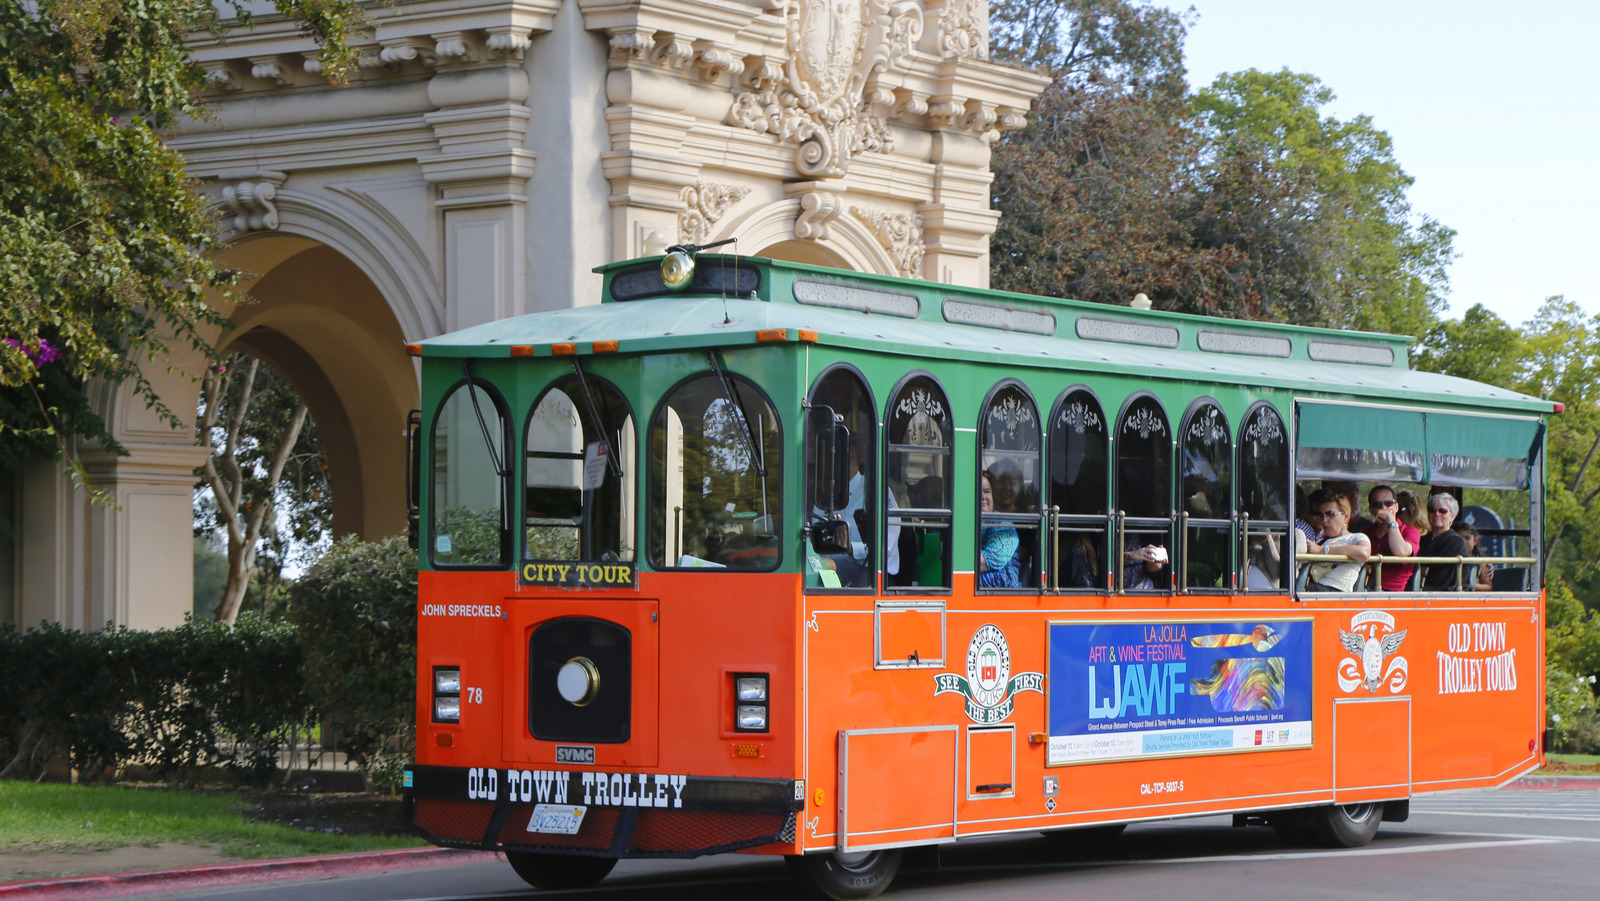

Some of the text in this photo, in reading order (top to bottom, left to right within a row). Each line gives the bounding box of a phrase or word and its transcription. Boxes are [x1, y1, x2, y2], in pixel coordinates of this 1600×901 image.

[524, 564, 631, 584] CITY TOUR
[422, 604, 501, 618] JOHN SPRECKELS
[1144, 625, 1186, 642] LA JOLLA
[1448, 622, 1506, 653] OLD TOWN
[1089, 644, 1186, 663] ART & WINE FESTIVAL
[1436, 648, 1517, 694] TROLLEY TOURS
[940, 676, 960, 690] SEE
[1014, 675, 1040, 690] FIRST
[1088, 662, 1186, 719] LJAWF
[467, 687, 482, 704] 78
[968, 700, 1011, 722] THE BEST
[558, 748, 593, 761] SVMC
[468, 768, 686, 808] OLD TOWN TROLLEY
[796, 786, 803, 798] 20
